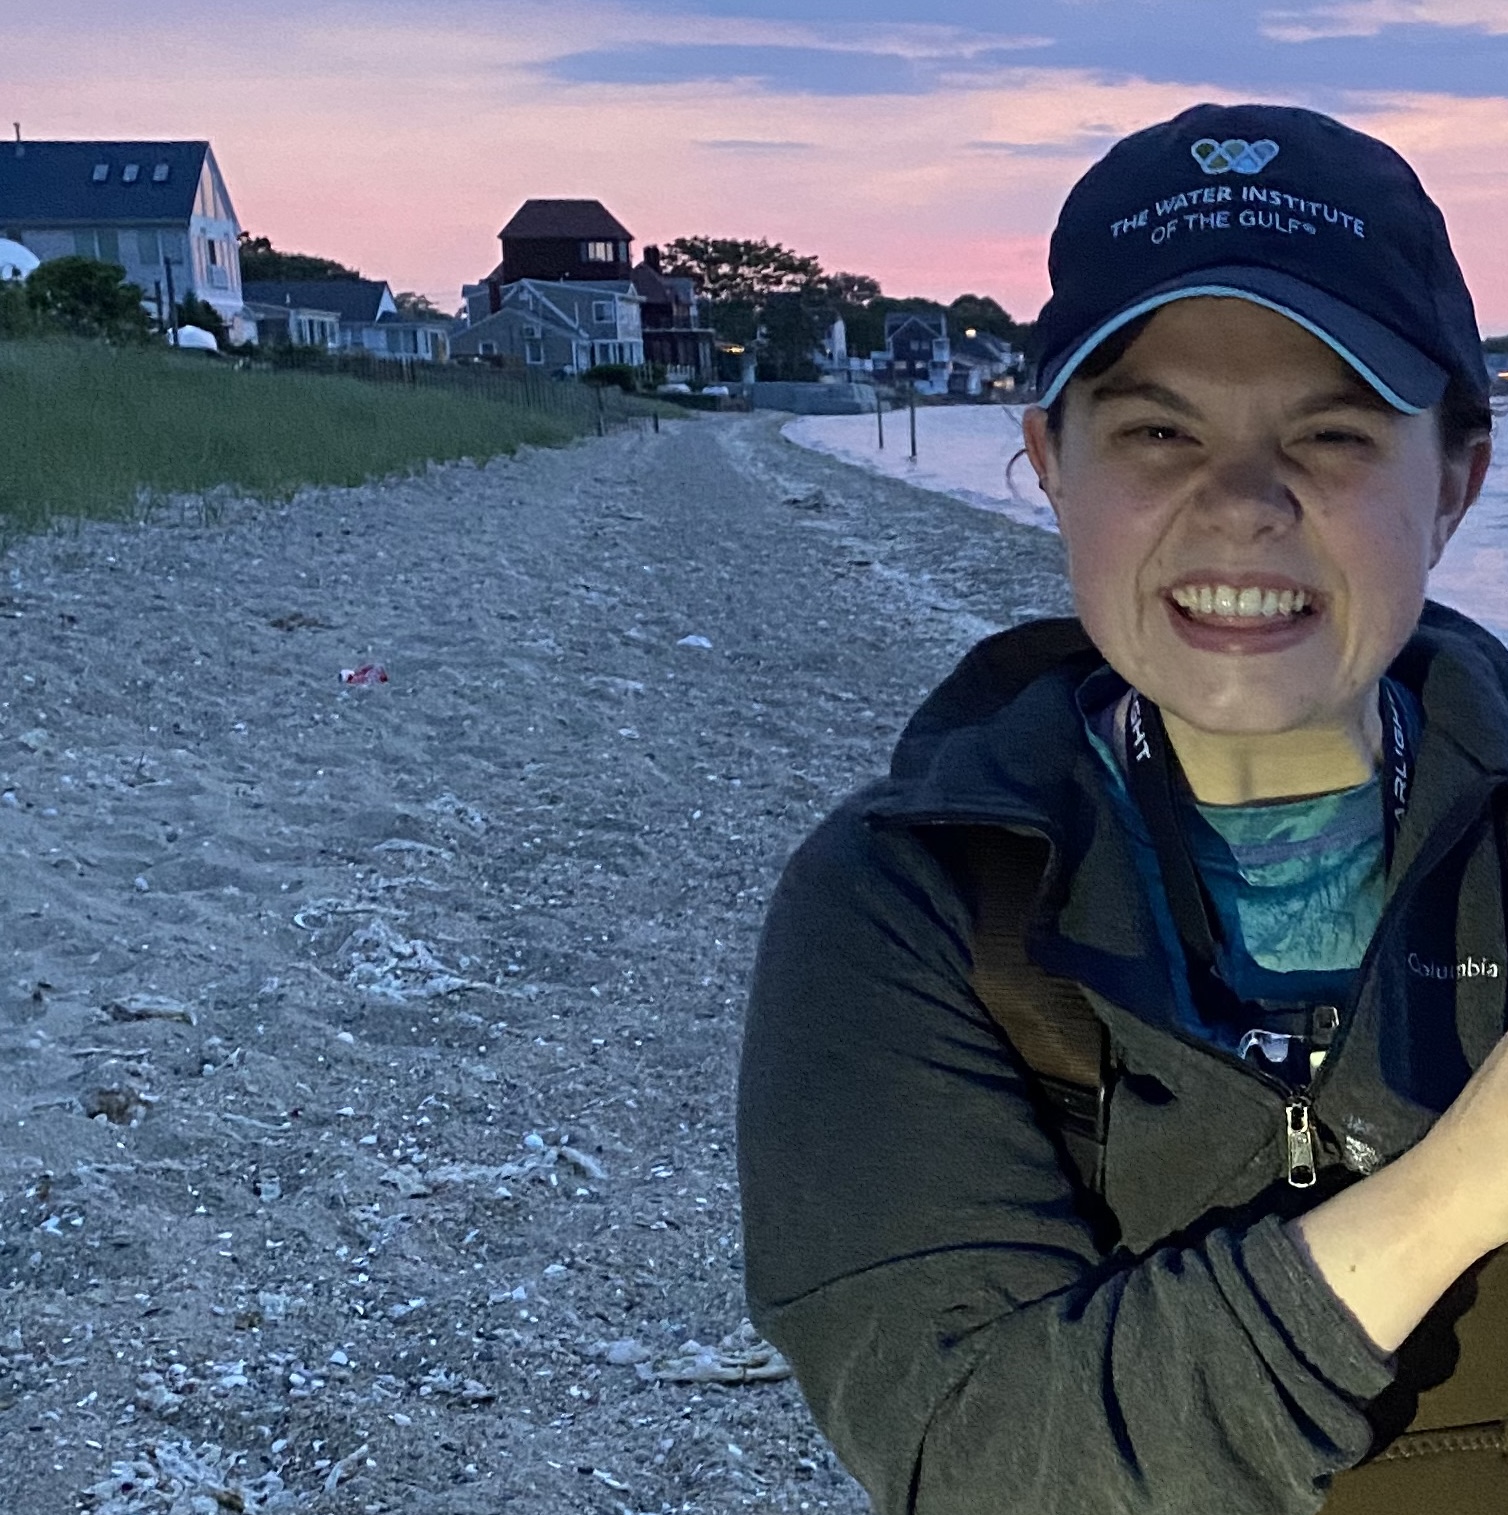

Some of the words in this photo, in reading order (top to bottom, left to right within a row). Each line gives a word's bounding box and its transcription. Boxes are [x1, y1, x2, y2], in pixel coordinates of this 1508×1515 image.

[1110, 209, 1149, 238] THE
[1155, 186, 1232, 216] WATER
[1241, 185, 1365, 238] INSTITUTE
[1151, 219, 1178, 244] OF
[1184, 211, 1231, 231] THE
